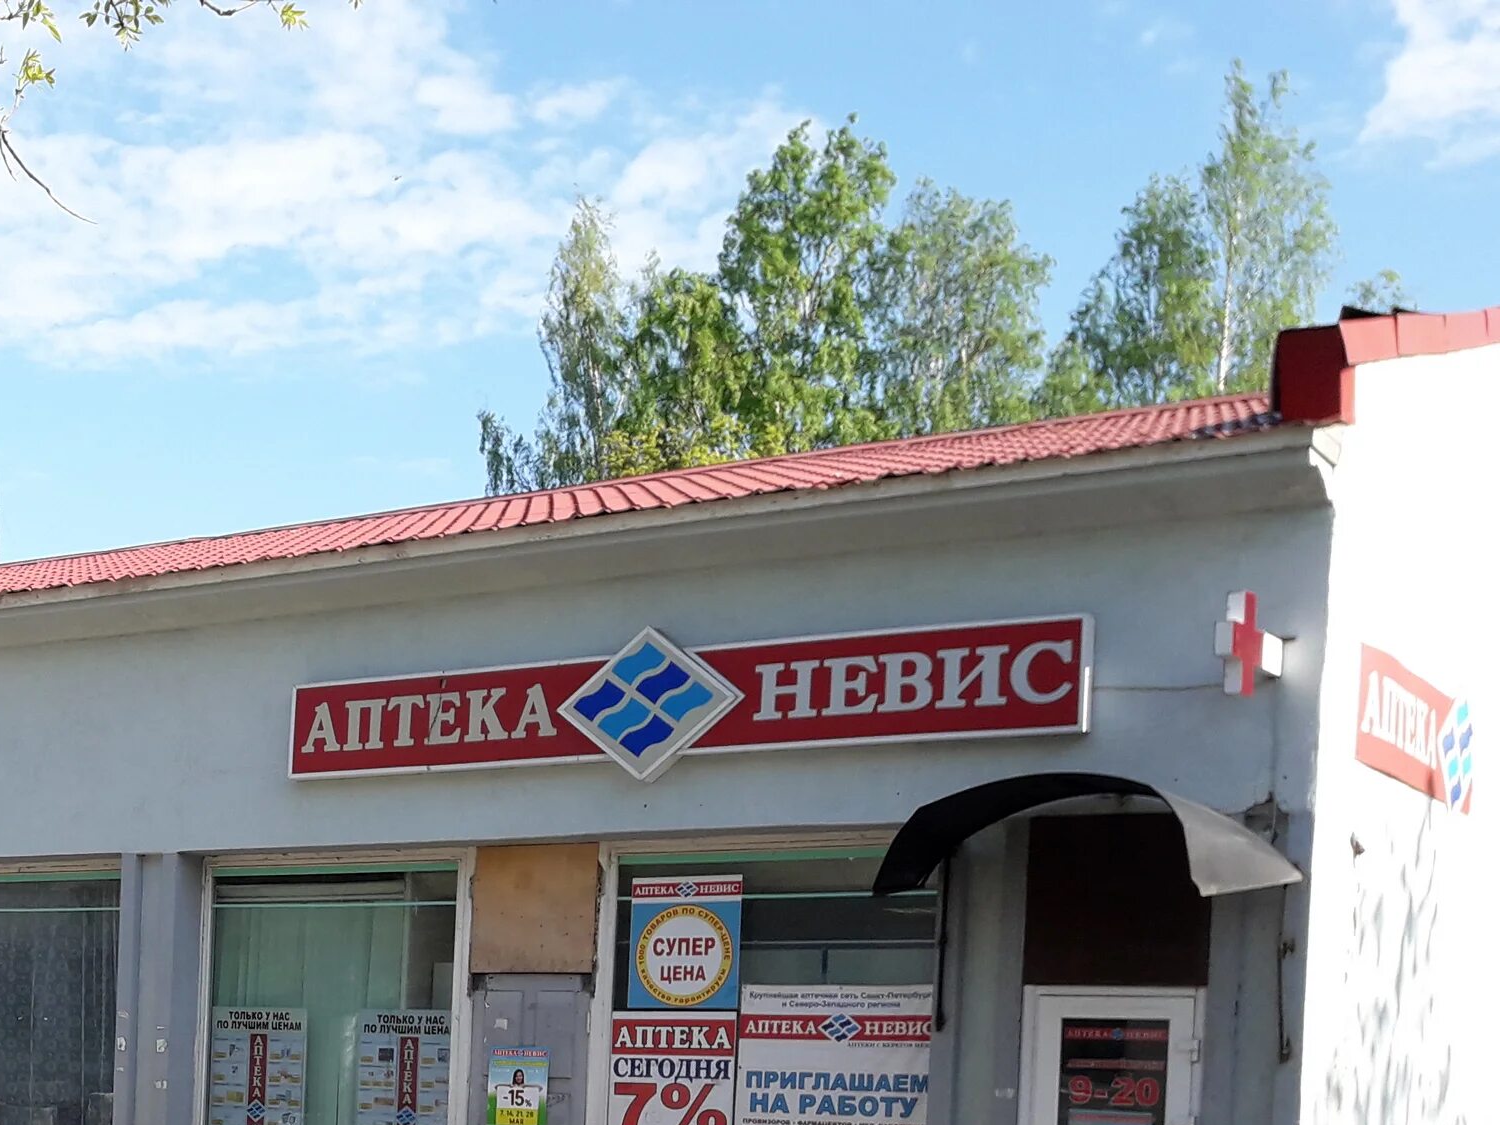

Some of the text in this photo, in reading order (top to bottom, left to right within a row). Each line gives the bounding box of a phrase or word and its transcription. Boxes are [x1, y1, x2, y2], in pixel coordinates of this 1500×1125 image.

[301, 639, 1074, 754] АПТЕКА НЕВИС
[1360, 670, 1437, 770] АПТЕКА
[635, 884, 740, 896] АПТЕКА НЕВИС
[638, 907, 731, 965] 1000 ТОВАРОВ ПО СУПЕР-ЦЕНЕ
[653, 937, 716, 956] СУПЕР
[641, 968, 672, 1002] качество
[660, 965, 706, 985] ЦЕНА
[749, 991, 799, 1000] Крупнейшая
[800, 992, 838, 1000] аптечная
[840, 992, 858, 1000] сеть
[216, 1020, 302, 1031] ПО ЛУЧШИМ ЦЕНАМ
[229, 1011, 290, 1021] ТОЛЬКО У НАС
[377, 1014, 445, 1025] ТОЛЬКО У НАС
[363, 1024, 377, 1034] ПО
[379, 1024, 422, 1034] ЛУЧШИМ
[614, 1025, 732, 1049] АПТЕКА
[745, 1020, 818, 1035] АПТЕКА
[252, 1035, 264, 1098] АПТЕКА
[402, 1038, 414, 1105] АПТЕКА
[613, 1057, 732, 1083] СЕГОДНЯ
[746, 1070, 928, 1092] ПРИГЛАШАЕМ
[1068, 1075, 1160, 1107] 9-20
[503, 1090, 532, 1108] -15%
[749, 1092, 918, 1118] НА РАБОТУ
[742, 1118, 790, 1125] ПРОВИЗОРОВ
